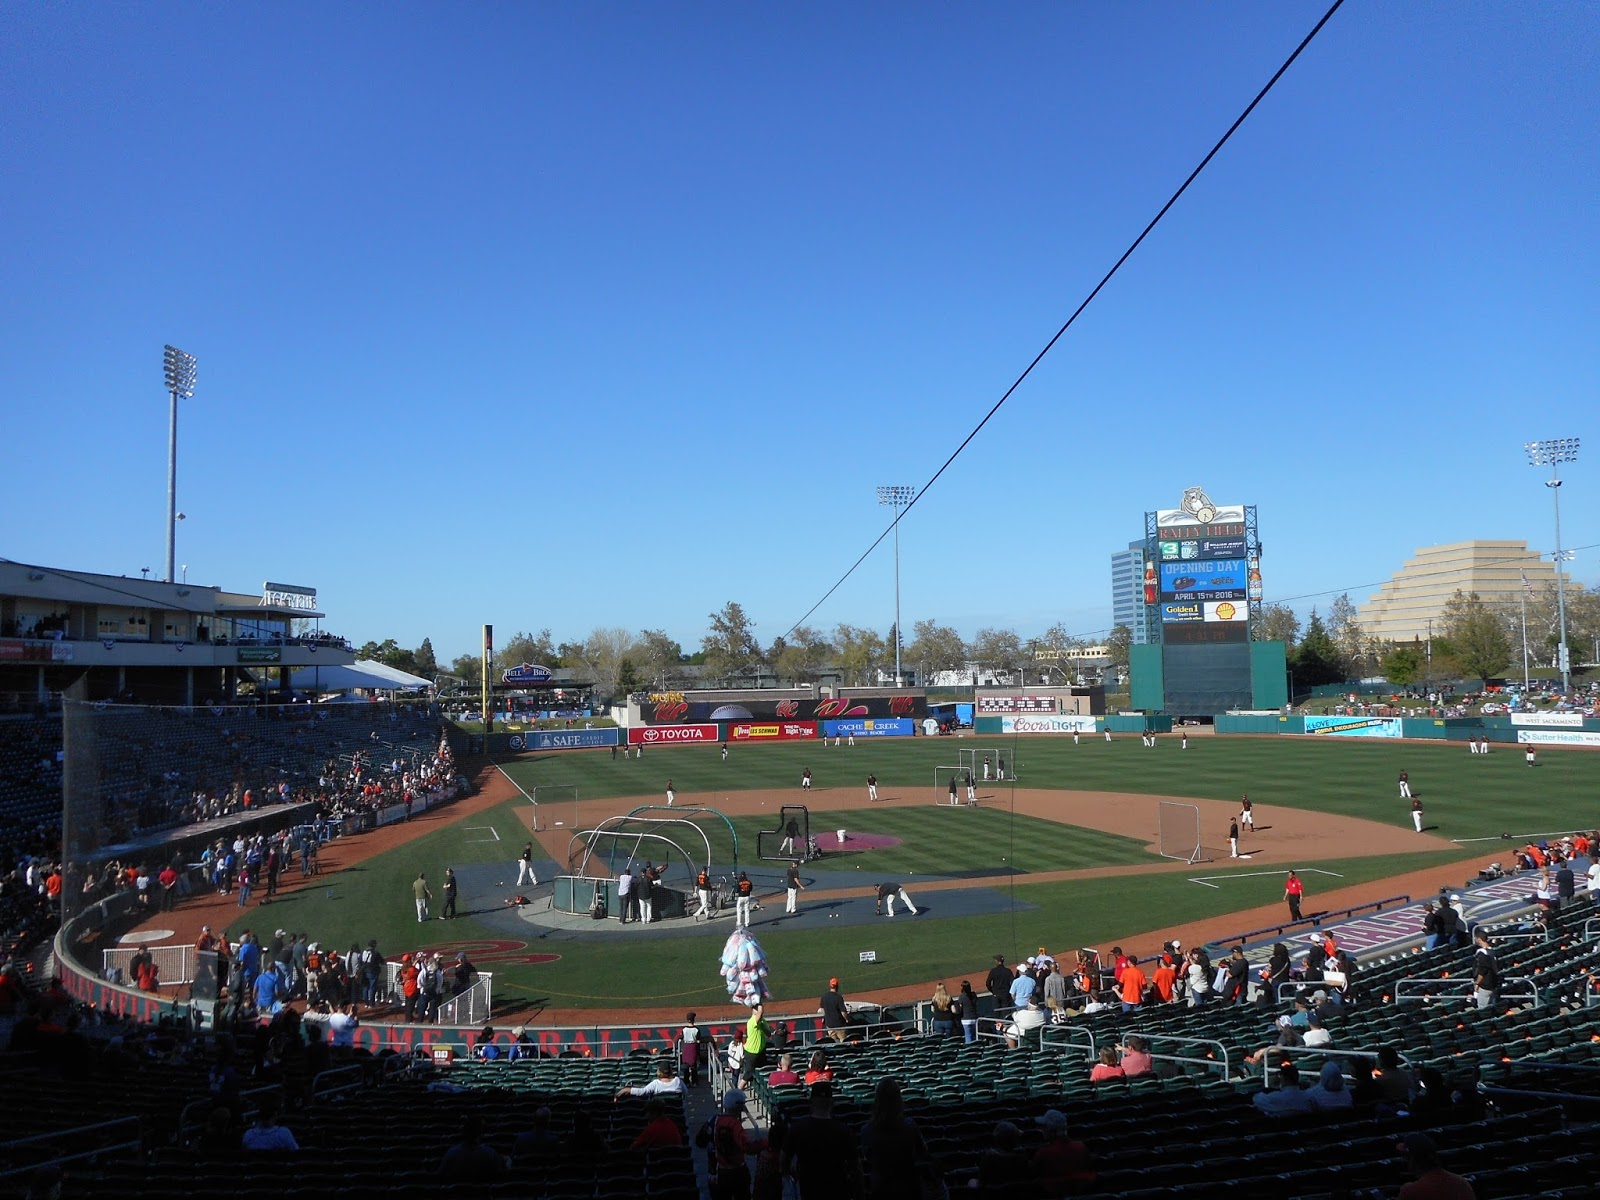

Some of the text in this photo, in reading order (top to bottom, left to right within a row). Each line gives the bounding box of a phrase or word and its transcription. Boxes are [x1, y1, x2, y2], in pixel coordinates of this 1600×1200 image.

[1160, 525, 1243, 539] RALEY FIELD
[1163, 543, 1177, 554] 3
[1165, 560, 1240, 574] OPENING DAY
[874, 722, 899, 730] CREEK
[1013, 718, 1085, 732] Coors LIGHT
[660, 729, 703, 739] TOYOTA
[1532, 733, 1556, 741] Sutter
[1557, 733, 1583, 742] Health
[553, 735, 581, 746] SAFE
